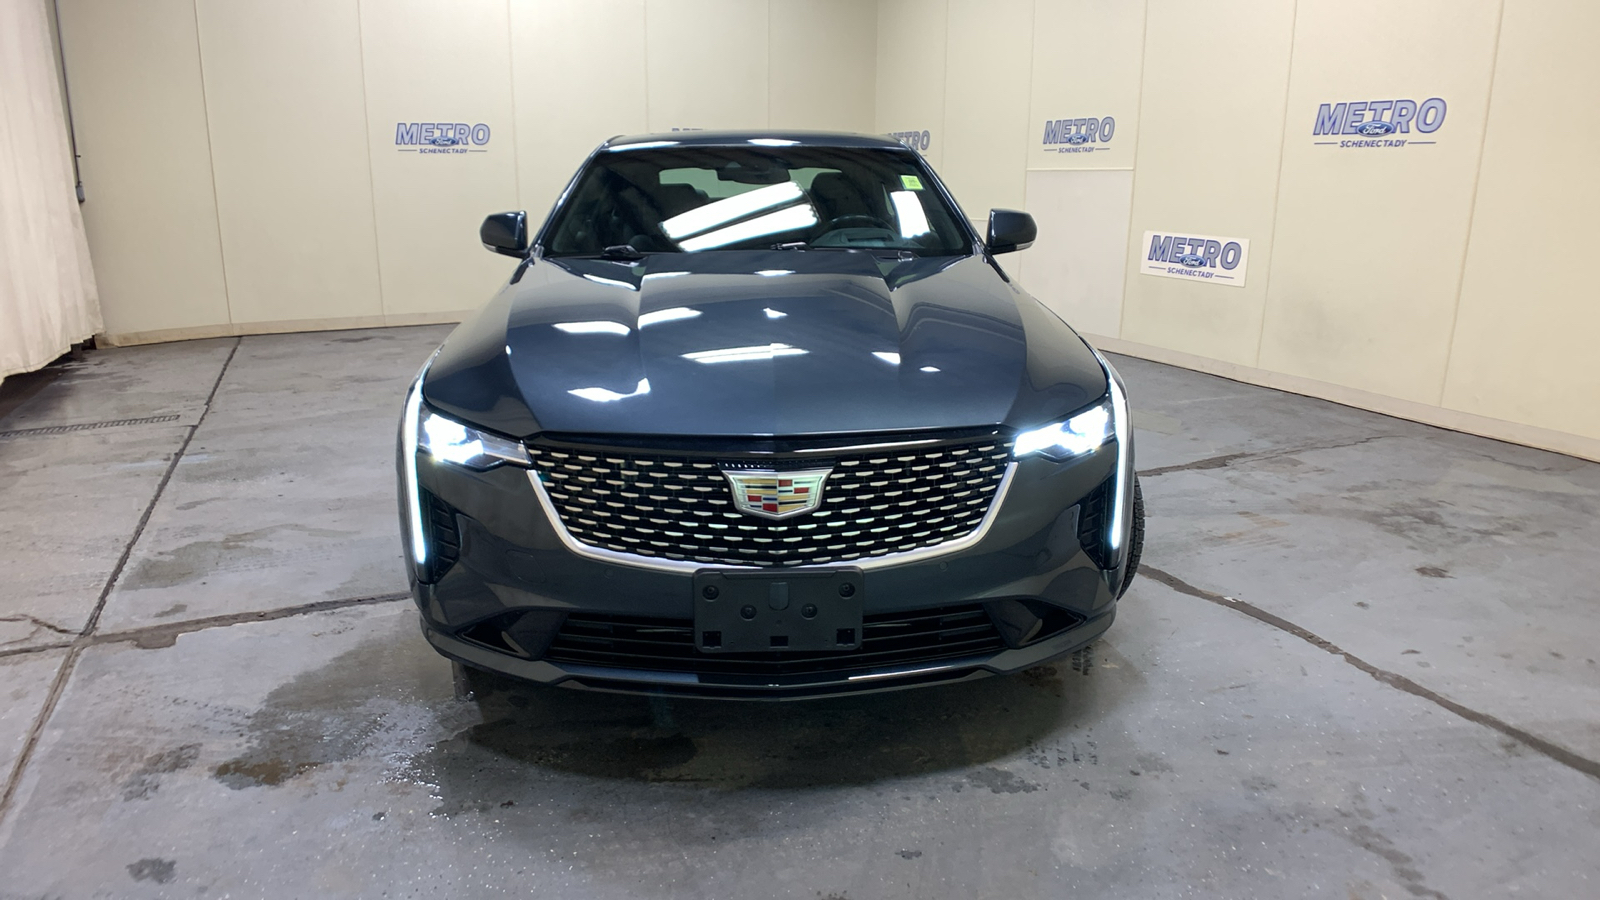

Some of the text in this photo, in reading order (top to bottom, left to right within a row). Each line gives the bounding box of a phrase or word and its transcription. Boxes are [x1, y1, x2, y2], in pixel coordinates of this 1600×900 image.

[1313, 98, 1447, 135] METRO
[395, 123, 490, 146] METRO
[1043, 116, 1115, 144] METRO
[1362, 124, 1388, 135] Ford
[1147, 235, 1242, 270] METRO
[1167, 267, 1214, 279] SCHENECTADY
